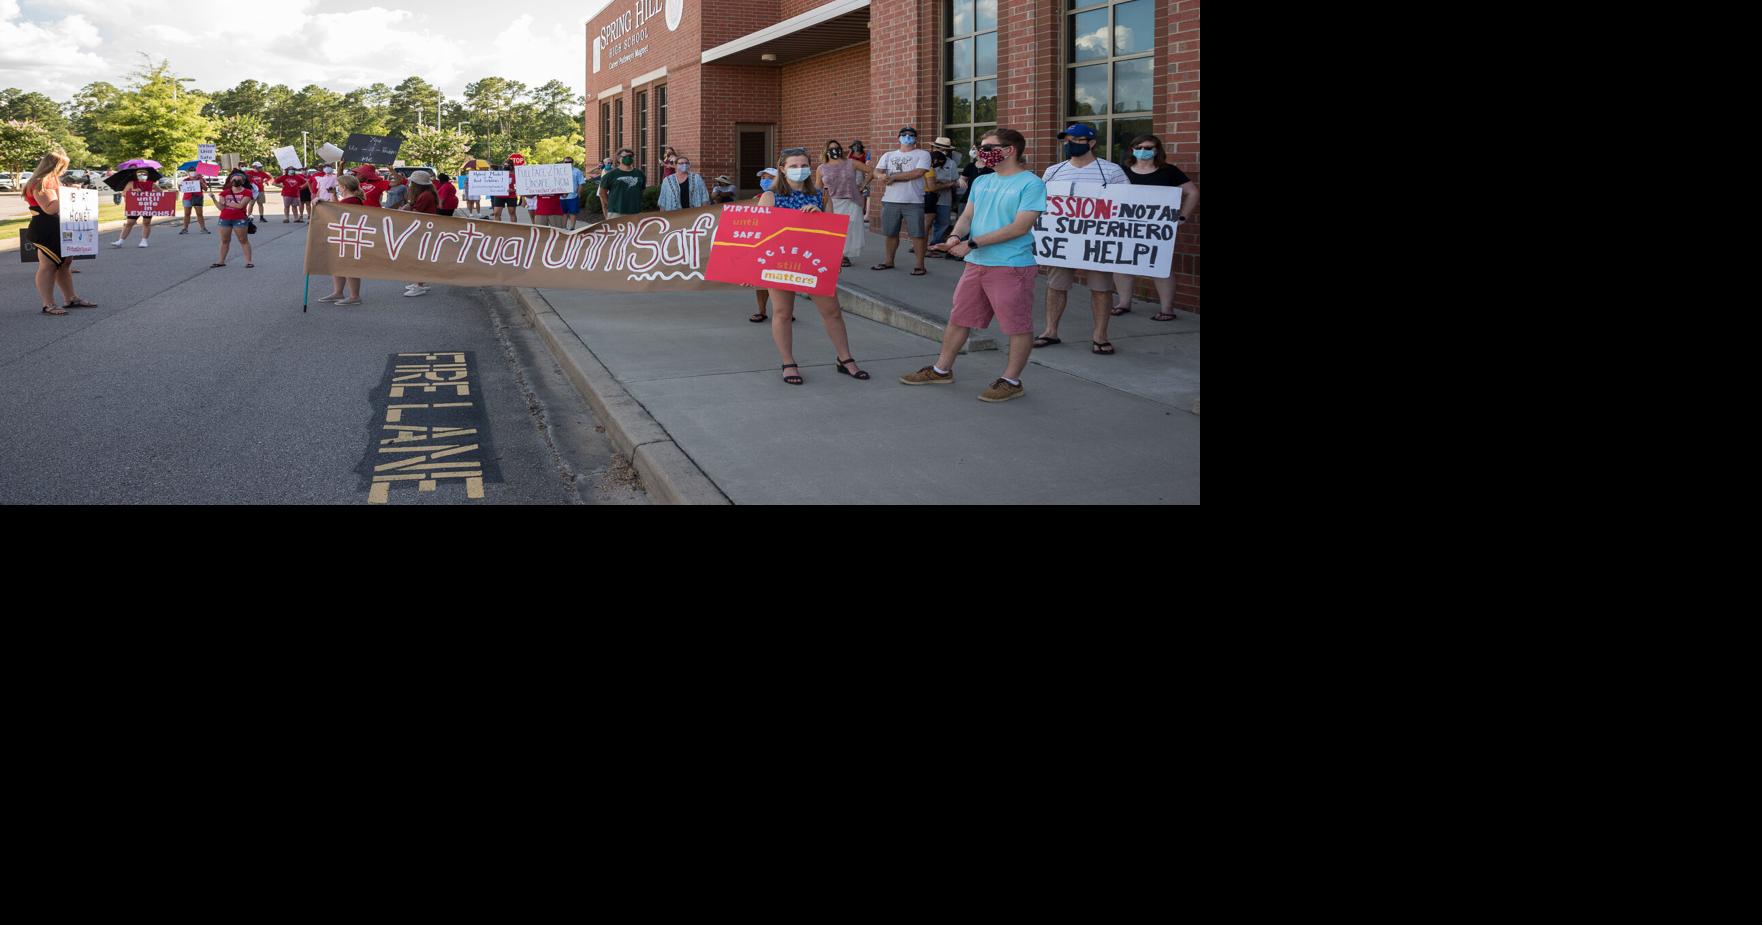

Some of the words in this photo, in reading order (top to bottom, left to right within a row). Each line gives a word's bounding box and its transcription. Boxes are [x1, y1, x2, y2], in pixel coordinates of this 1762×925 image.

[601, 10, 632, 50] SPRING
[635, 0, 663, 28] HILL
[624, 27, 649, 50] SCHOOL
[722, 204, 772, 214] VIRTUAL
[1046, 196, 1118, 220] SSION:
[732, 218, 759, 227] until
[1055, 216, 1174, 241] SUPERHERO
[327, 212, 718, 273] #VirtualUntilSaf
[732, 230, 763, 240] SAFE
[757, 245, 828, 274] SCIENCE
[1083, 239, 1159, 268] HELP!
[776, 261, 802, 271] still
[764, 271, 815, 286] matters
[389, 352, 470, 398] FIRE
[368, 402, 485, 504] LANE
